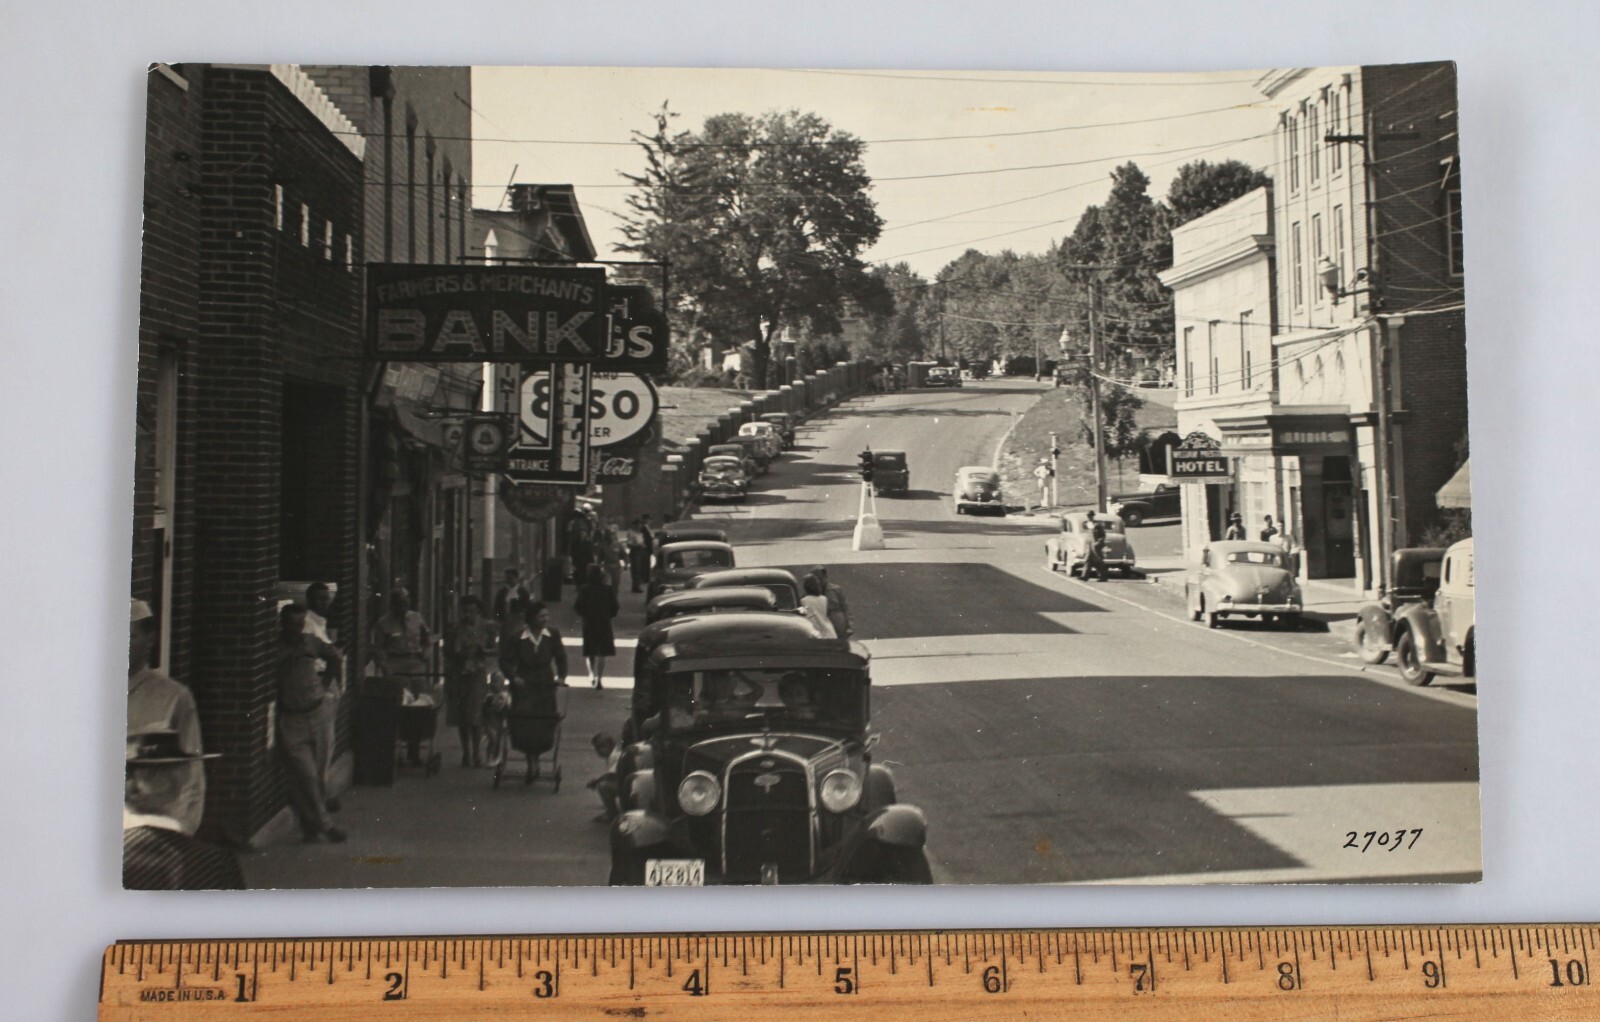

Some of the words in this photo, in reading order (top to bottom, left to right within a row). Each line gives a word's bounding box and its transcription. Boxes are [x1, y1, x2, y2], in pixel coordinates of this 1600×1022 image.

[377, 275, 459, 303] FARMERS
[462, 273, 477, 292] &
[480, 273, 595, 305] MERCHANTS
[378, 309, 595, 353] BANK
[560, 362, 584, 472] URNITURE
[507, 459, 549, 472] NTRANCE
[1175, 460, 1225, 473] HOTEL
[1343, 828, 1423, 853] 27037
[234, 974, 250, 1002] 1
[384, 972, 404, 1000] 2
[535, 971, 554, 998] 3
[683, 969, 703, 996] 4
[834, 967, 853, 995] 5
[983, 965, 1001, 994] 6
[1130, 964, 1148, 991] 7
[1277, 962, 1295, 990] 8
[1421, 960, 1440, 988] 9
[1549, 959, 1585, 987] 10
[140, 990, 175, 1001] MADE
[179, 990, 191, 1001] IN
